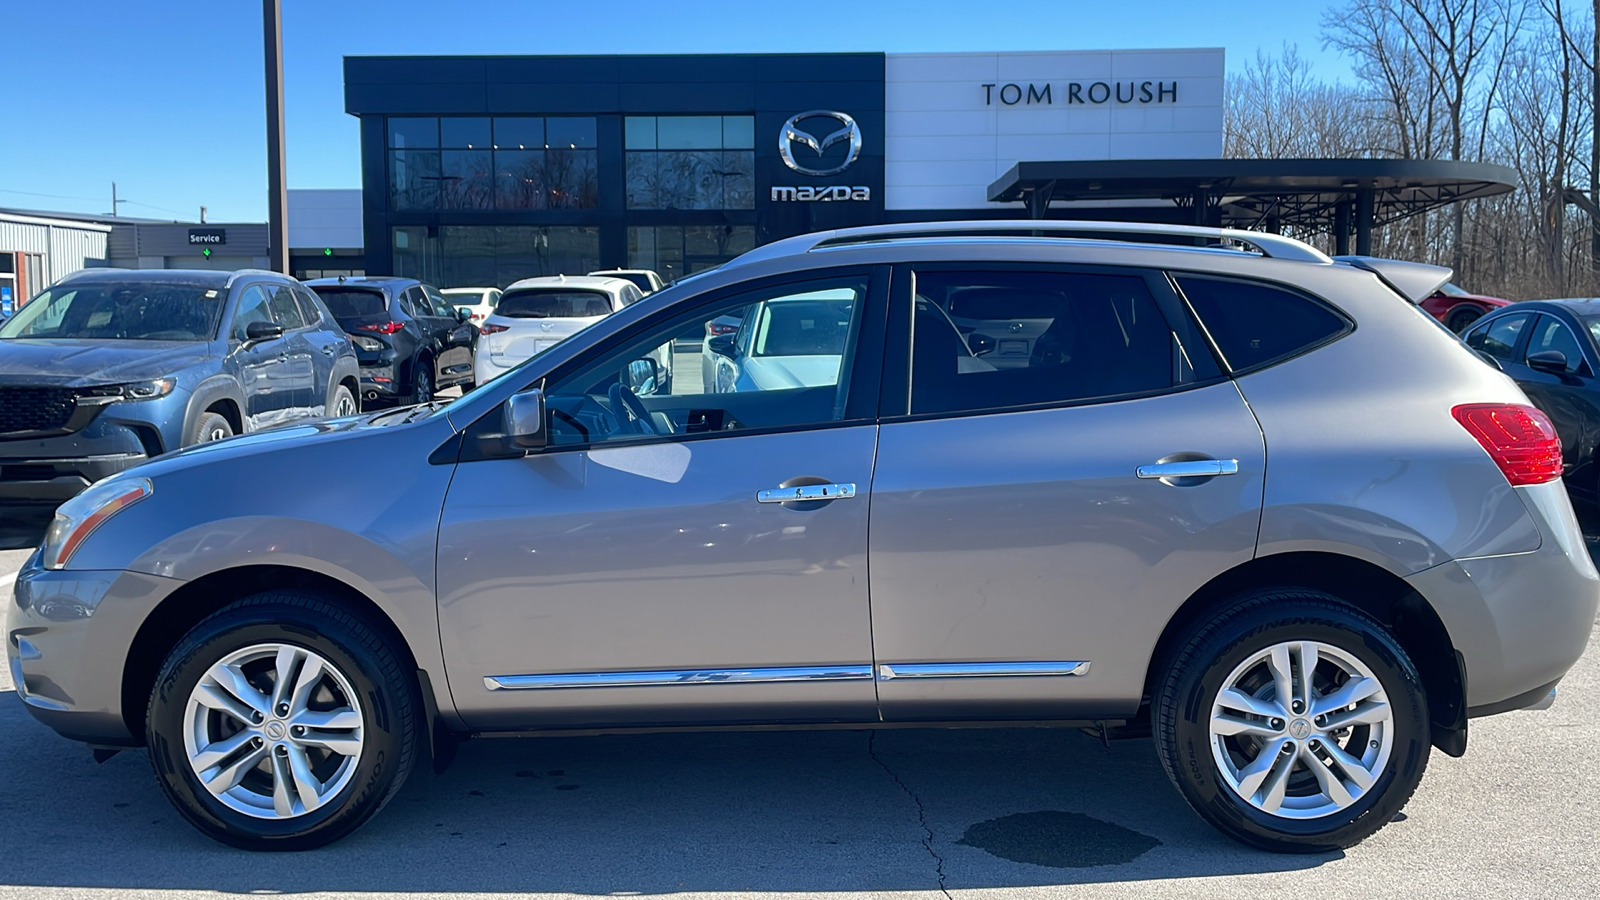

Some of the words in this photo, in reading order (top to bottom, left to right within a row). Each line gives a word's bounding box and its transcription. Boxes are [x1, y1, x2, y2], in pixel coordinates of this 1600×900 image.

[981, 83, 1052, 106] TOM
[1068, 81, 1178, 104] ROUSH
[190, 234, 220, 243] Service
